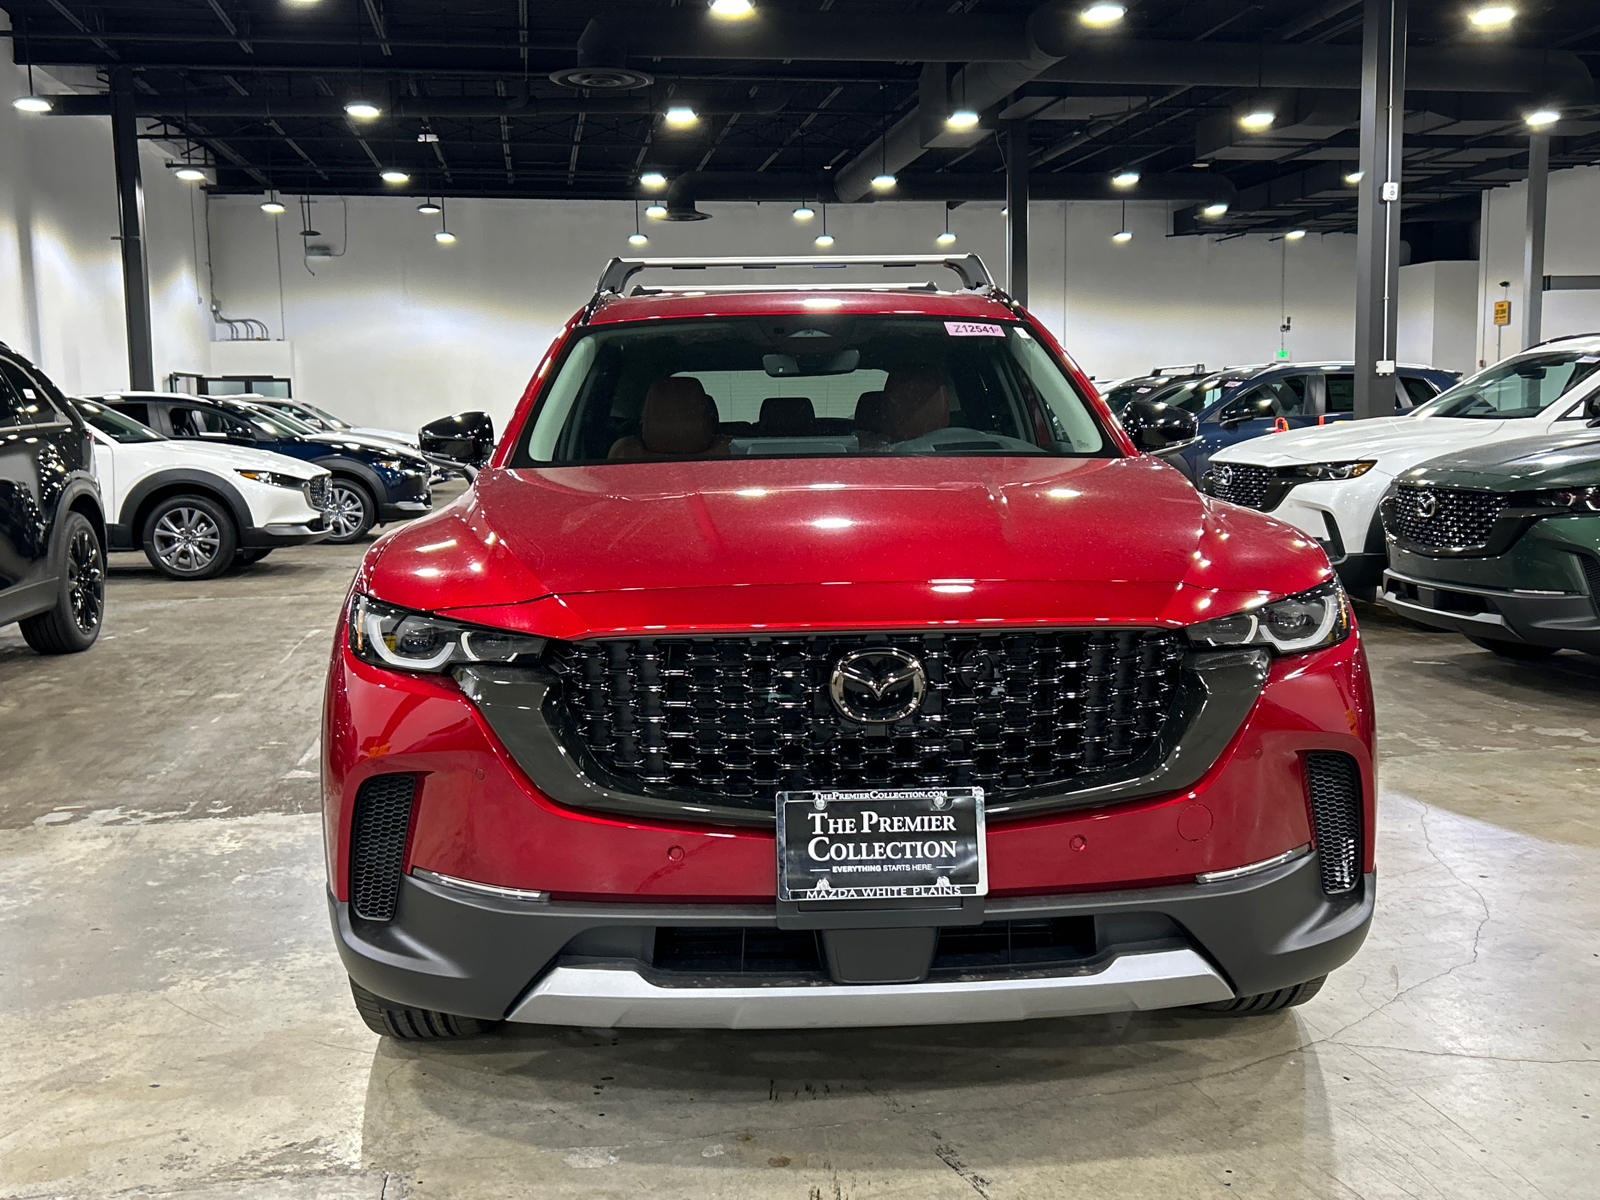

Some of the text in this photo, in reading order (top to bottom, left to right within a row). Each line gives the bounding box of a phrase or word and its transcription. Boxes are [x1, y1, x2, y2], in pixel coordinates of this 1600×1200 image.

[807, 811, 957, 835] THE PREMIER
[807, 836, 957, 862] COLLECTION
[832, 863, 934, 873] EVERYTHING STARTS HERE.
[806, 885, 961, 899] MAZDA WHITE PLAINS
